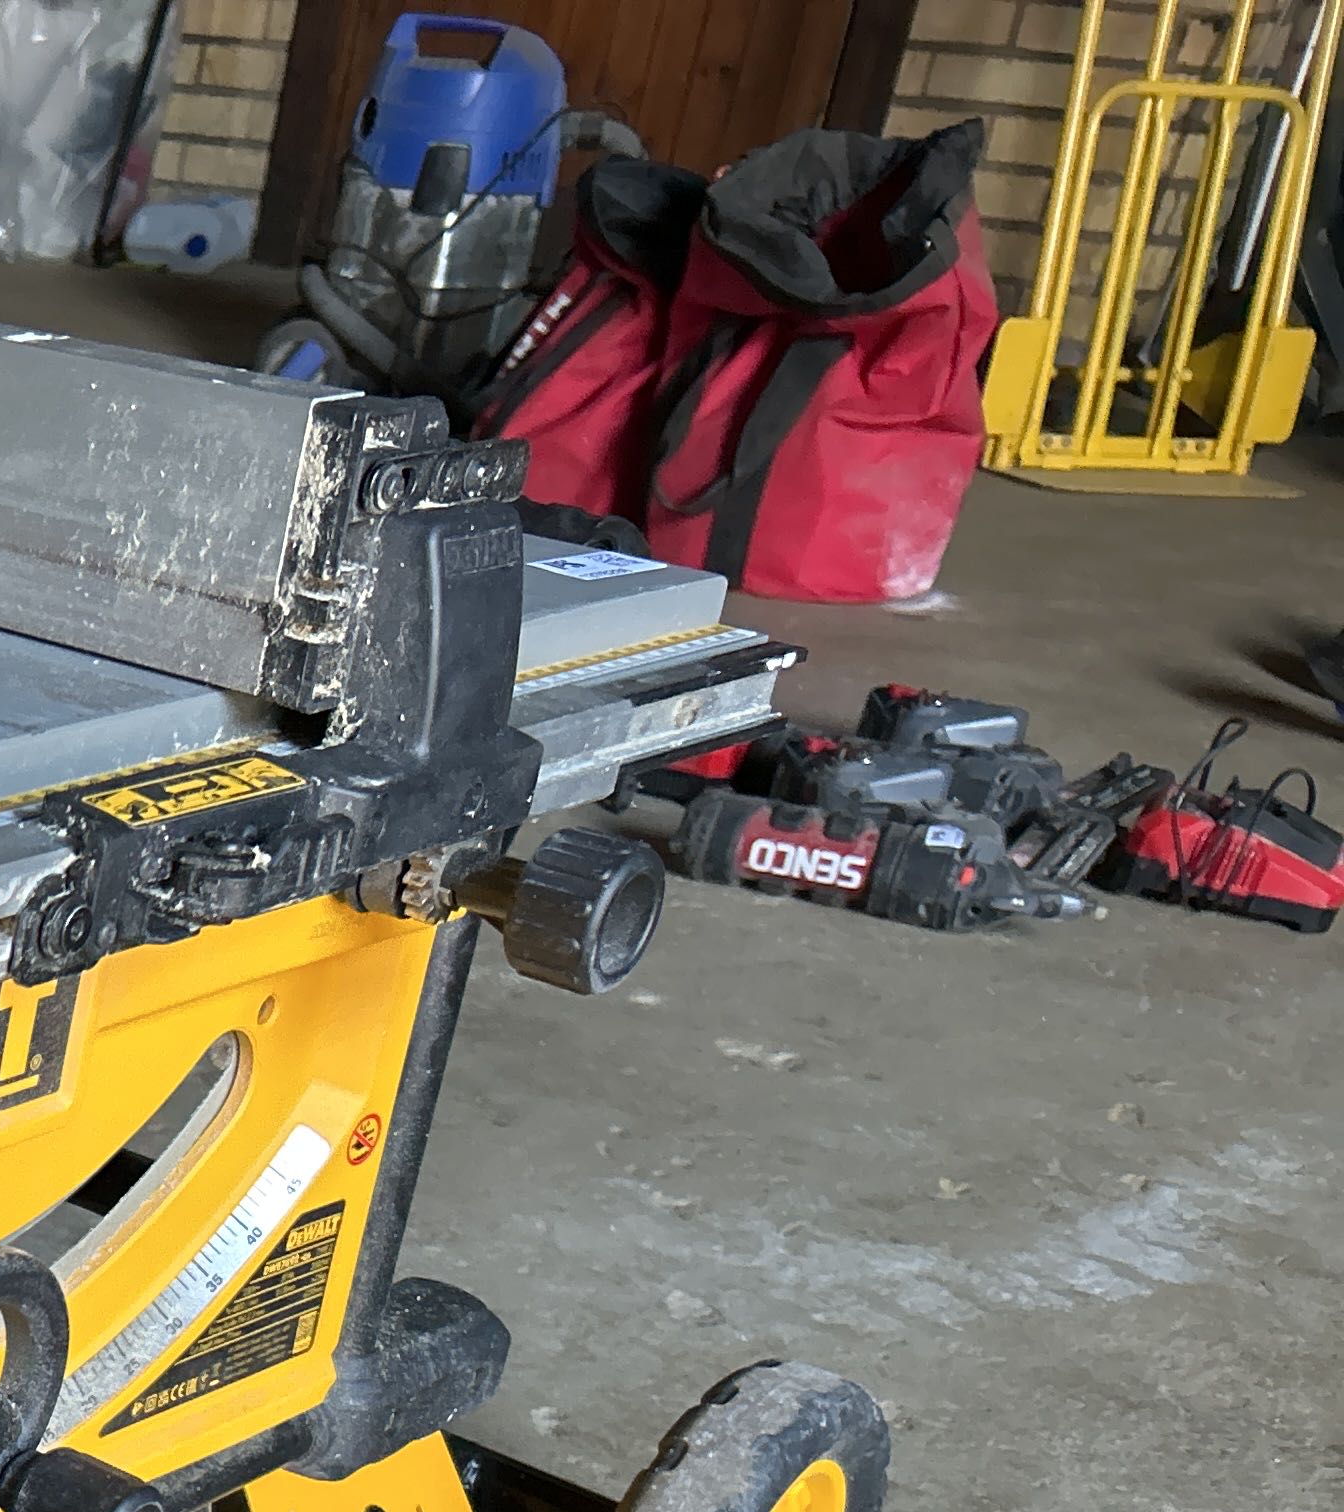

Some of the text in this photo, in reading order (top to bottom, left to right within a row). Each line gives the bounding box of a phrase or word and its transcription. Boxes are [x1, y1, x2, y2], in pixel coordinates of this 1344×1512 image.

[748, 838, 867, 890] SENCO
[286, 1178, 302, 1195] 45
[246, 1226, 263, 1245] 40
[287, 1215, 342, 1247] DEWALT
[205, 1272, 224, 1293] 35
[165, 1316, 183, 1335] 30
[123, 1358, 141, 1376] 25
